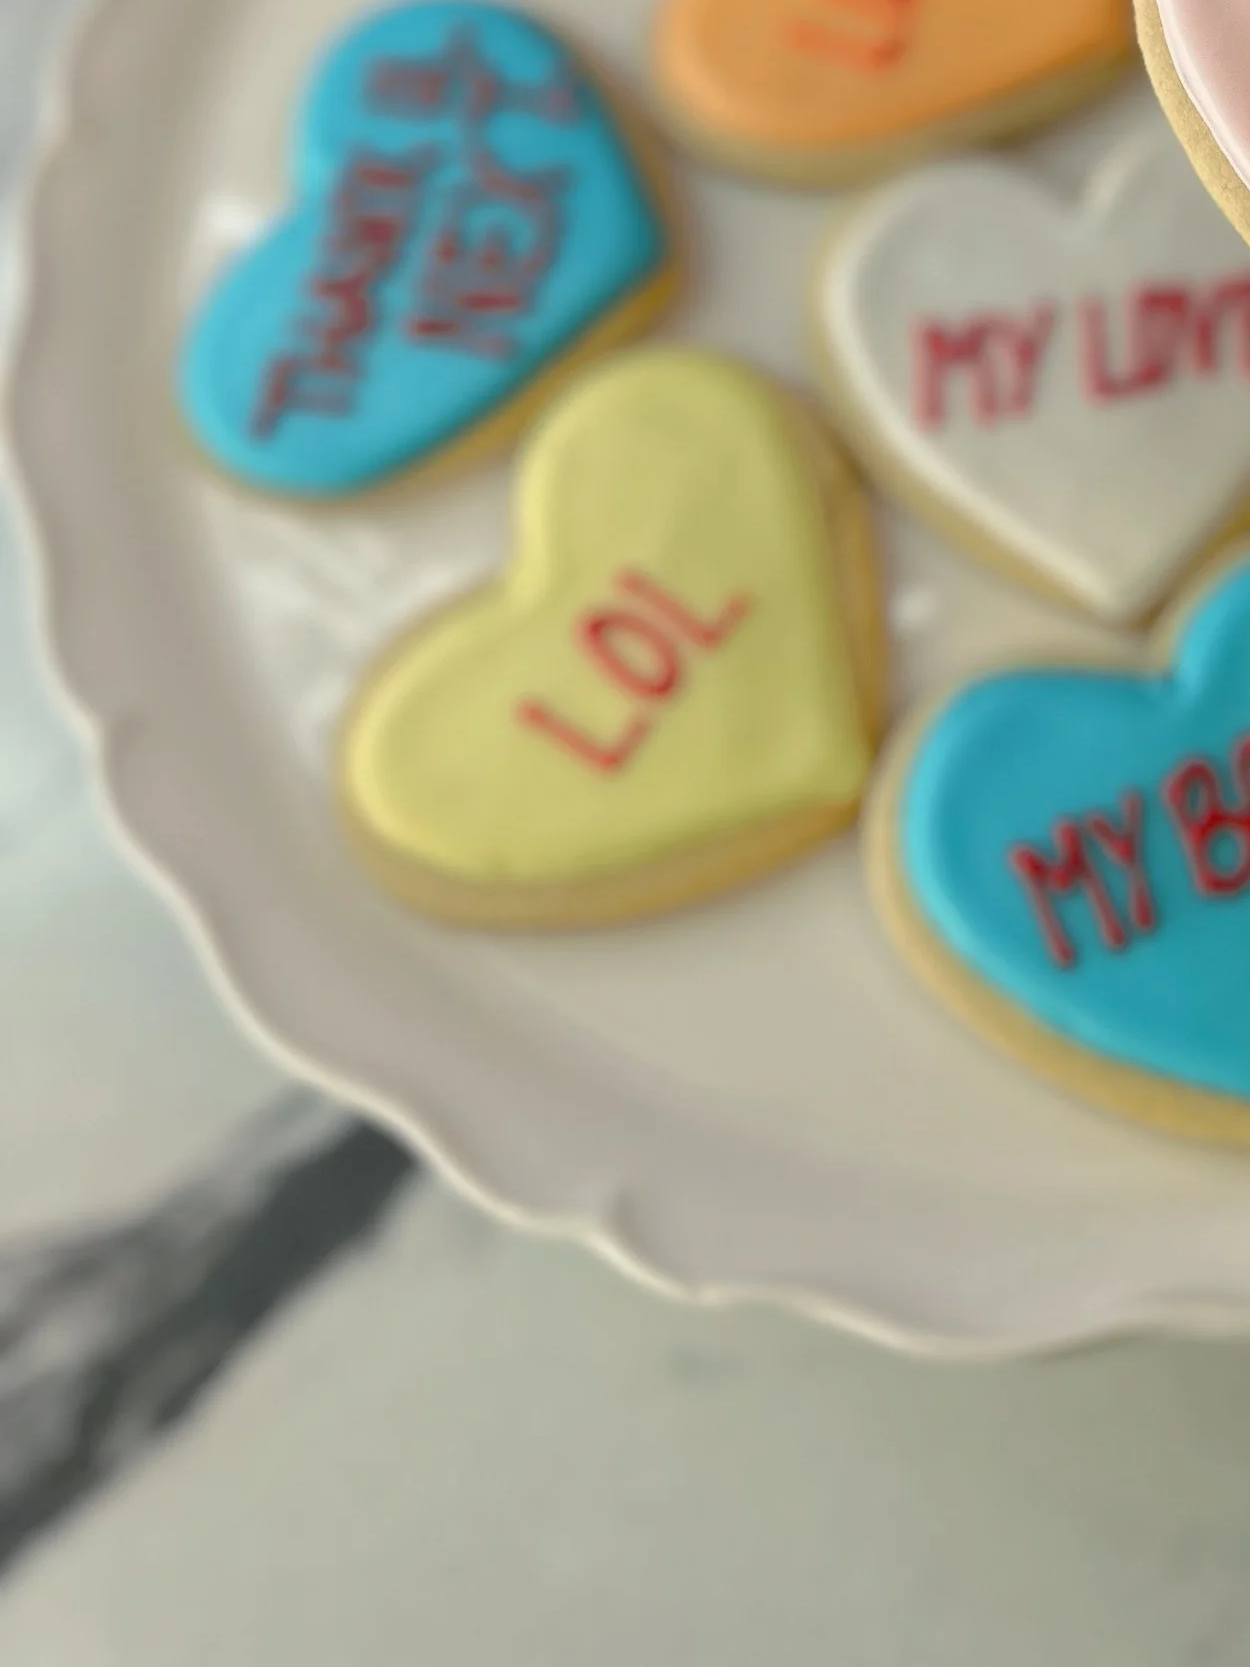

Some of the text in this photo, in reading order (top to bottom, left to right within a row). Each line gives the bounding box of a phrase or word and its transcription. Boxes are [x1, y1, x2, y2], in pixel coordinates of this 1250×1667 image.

[912, 294, 1054, 432] MY
[514, 566, 754, 778] LOL
[1008, 786, 1156, 972] MY
